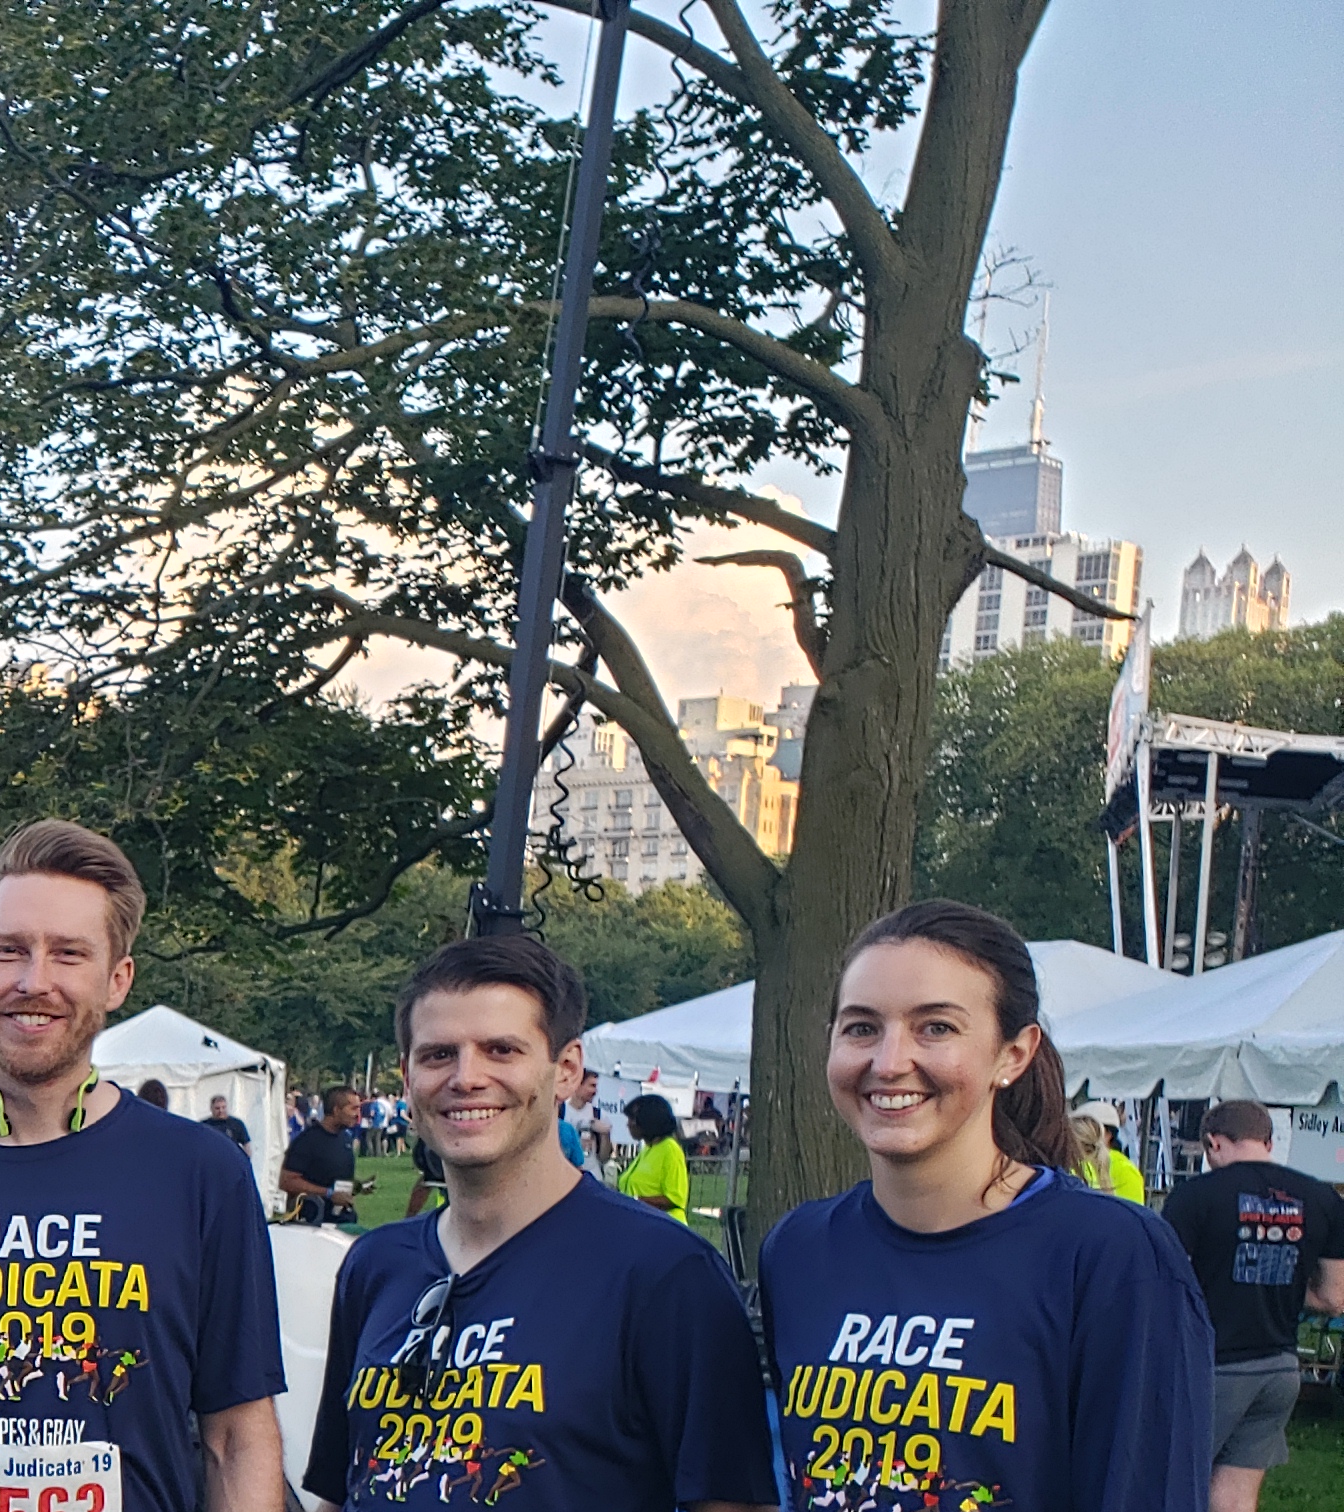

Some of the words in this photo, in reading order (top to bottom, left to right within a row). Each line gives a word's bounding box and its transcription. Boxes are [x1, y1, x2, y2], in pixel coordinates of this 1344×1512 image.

[1299, 1112, 1329, 1138] Sidley
[828, 1313, 975, 1370] RACE
[783, 1365, 1016, 1443] JUDICATA
[377, 1412, 483, 1460] 2019
[811, 1425, 941, 1491] 2019
